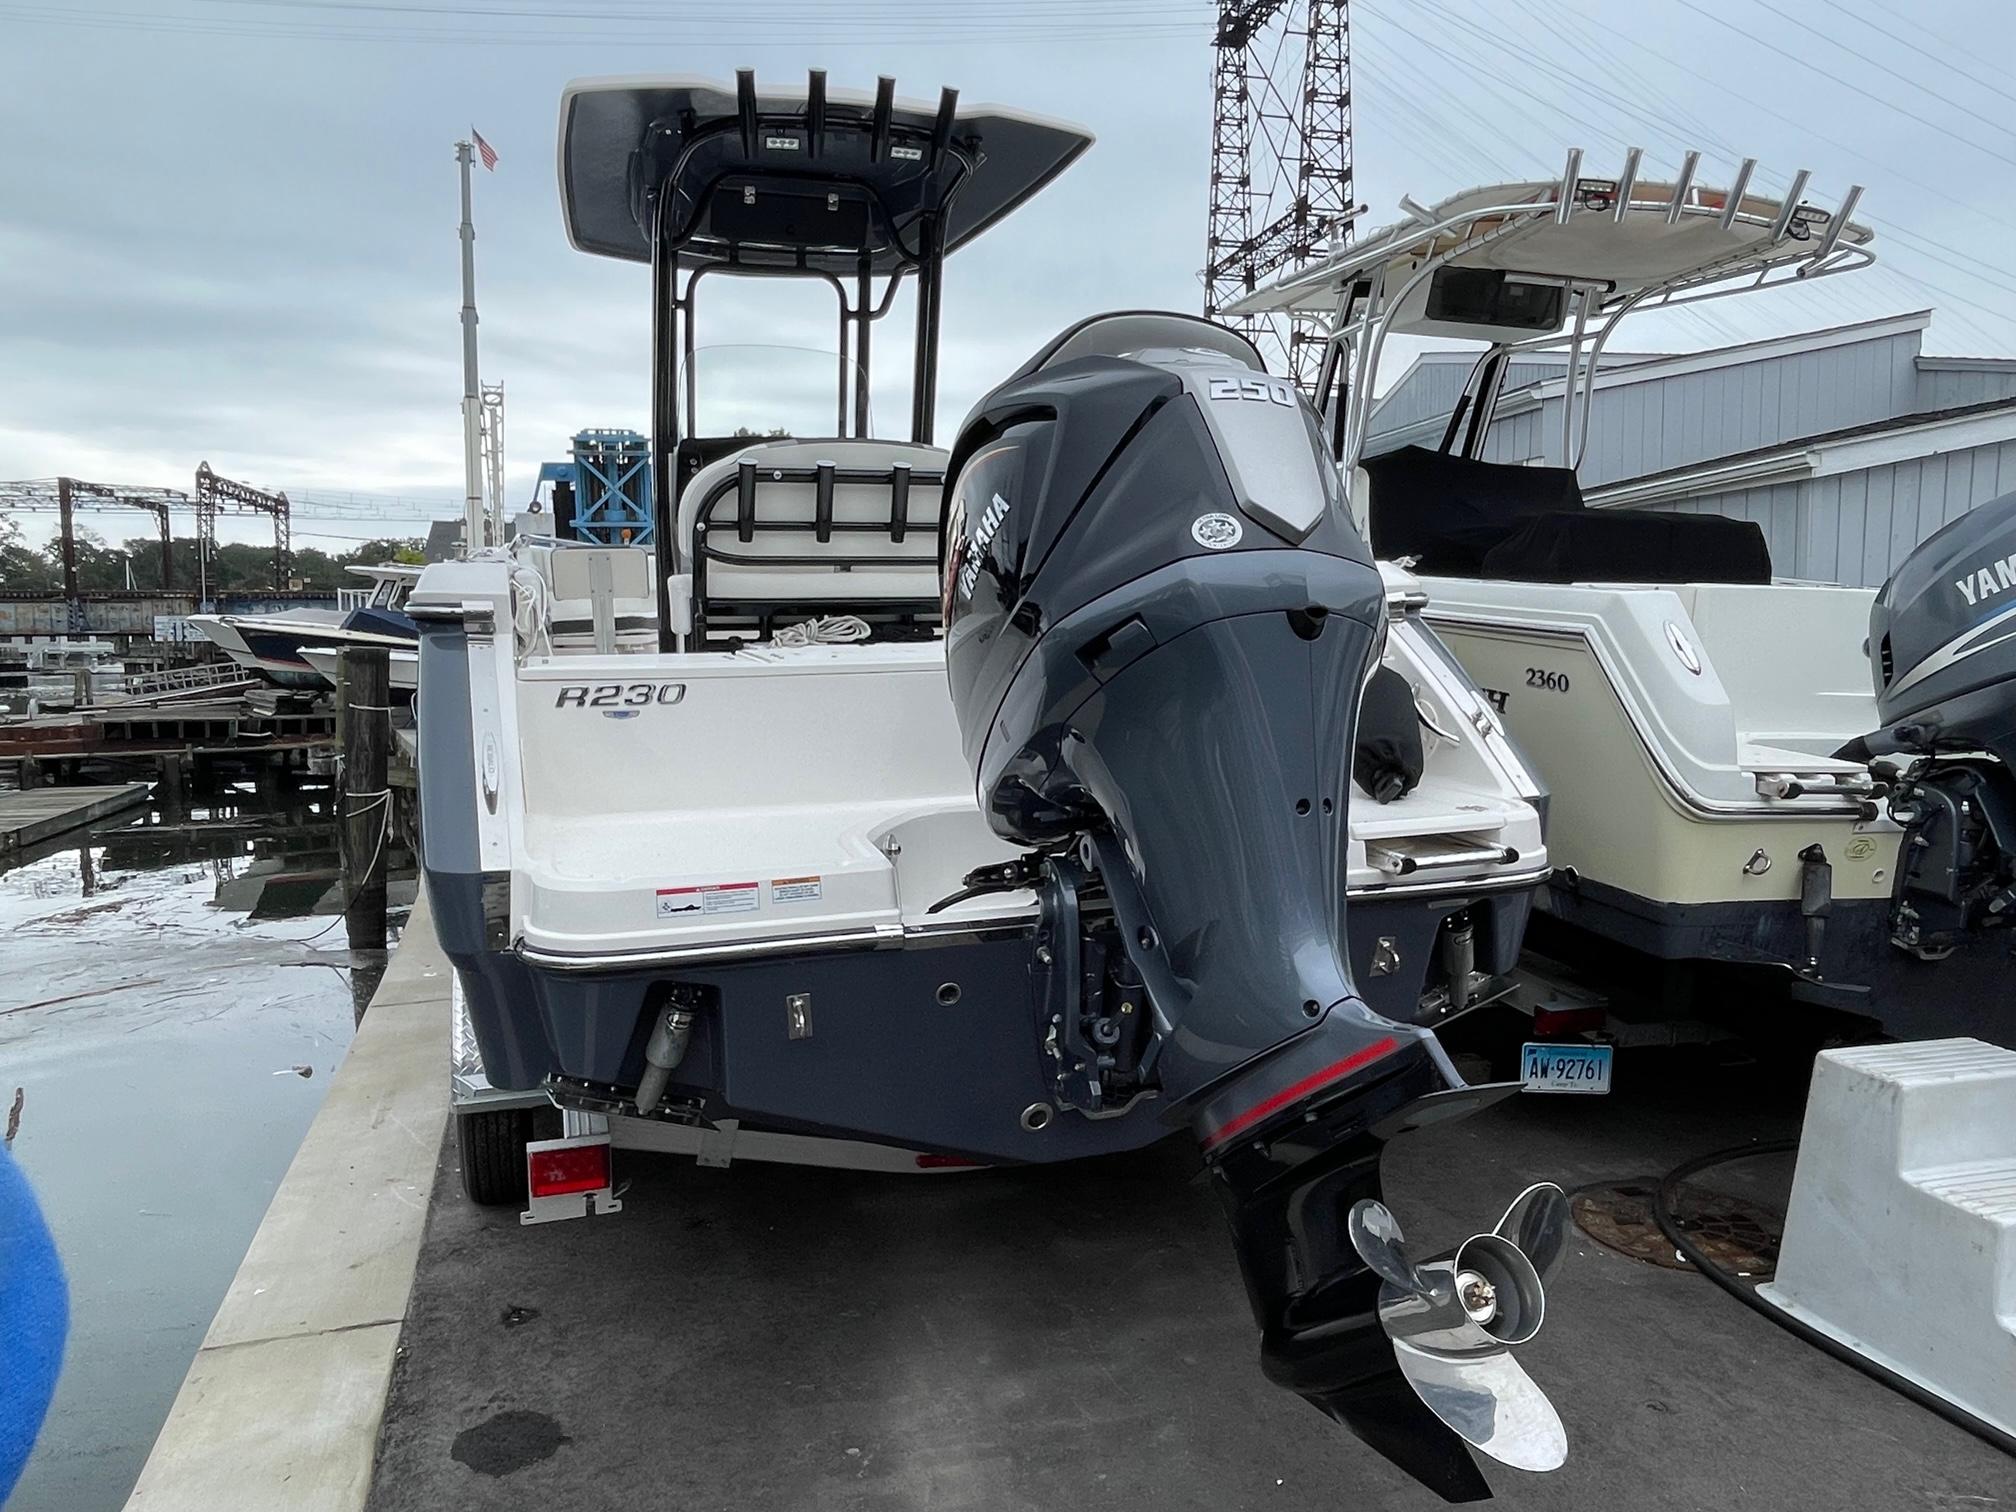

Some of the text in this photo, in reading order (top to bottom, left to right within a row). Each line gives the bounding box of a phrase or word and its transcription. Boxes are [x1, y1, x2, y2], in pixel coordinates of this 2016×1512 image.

[1208, 377, 1296, 408] 250
[960, 492, 1011, 601] YAMAHA
[1525, 667, 1570, 693] 2360
[555, 683, 687, 708] R230
